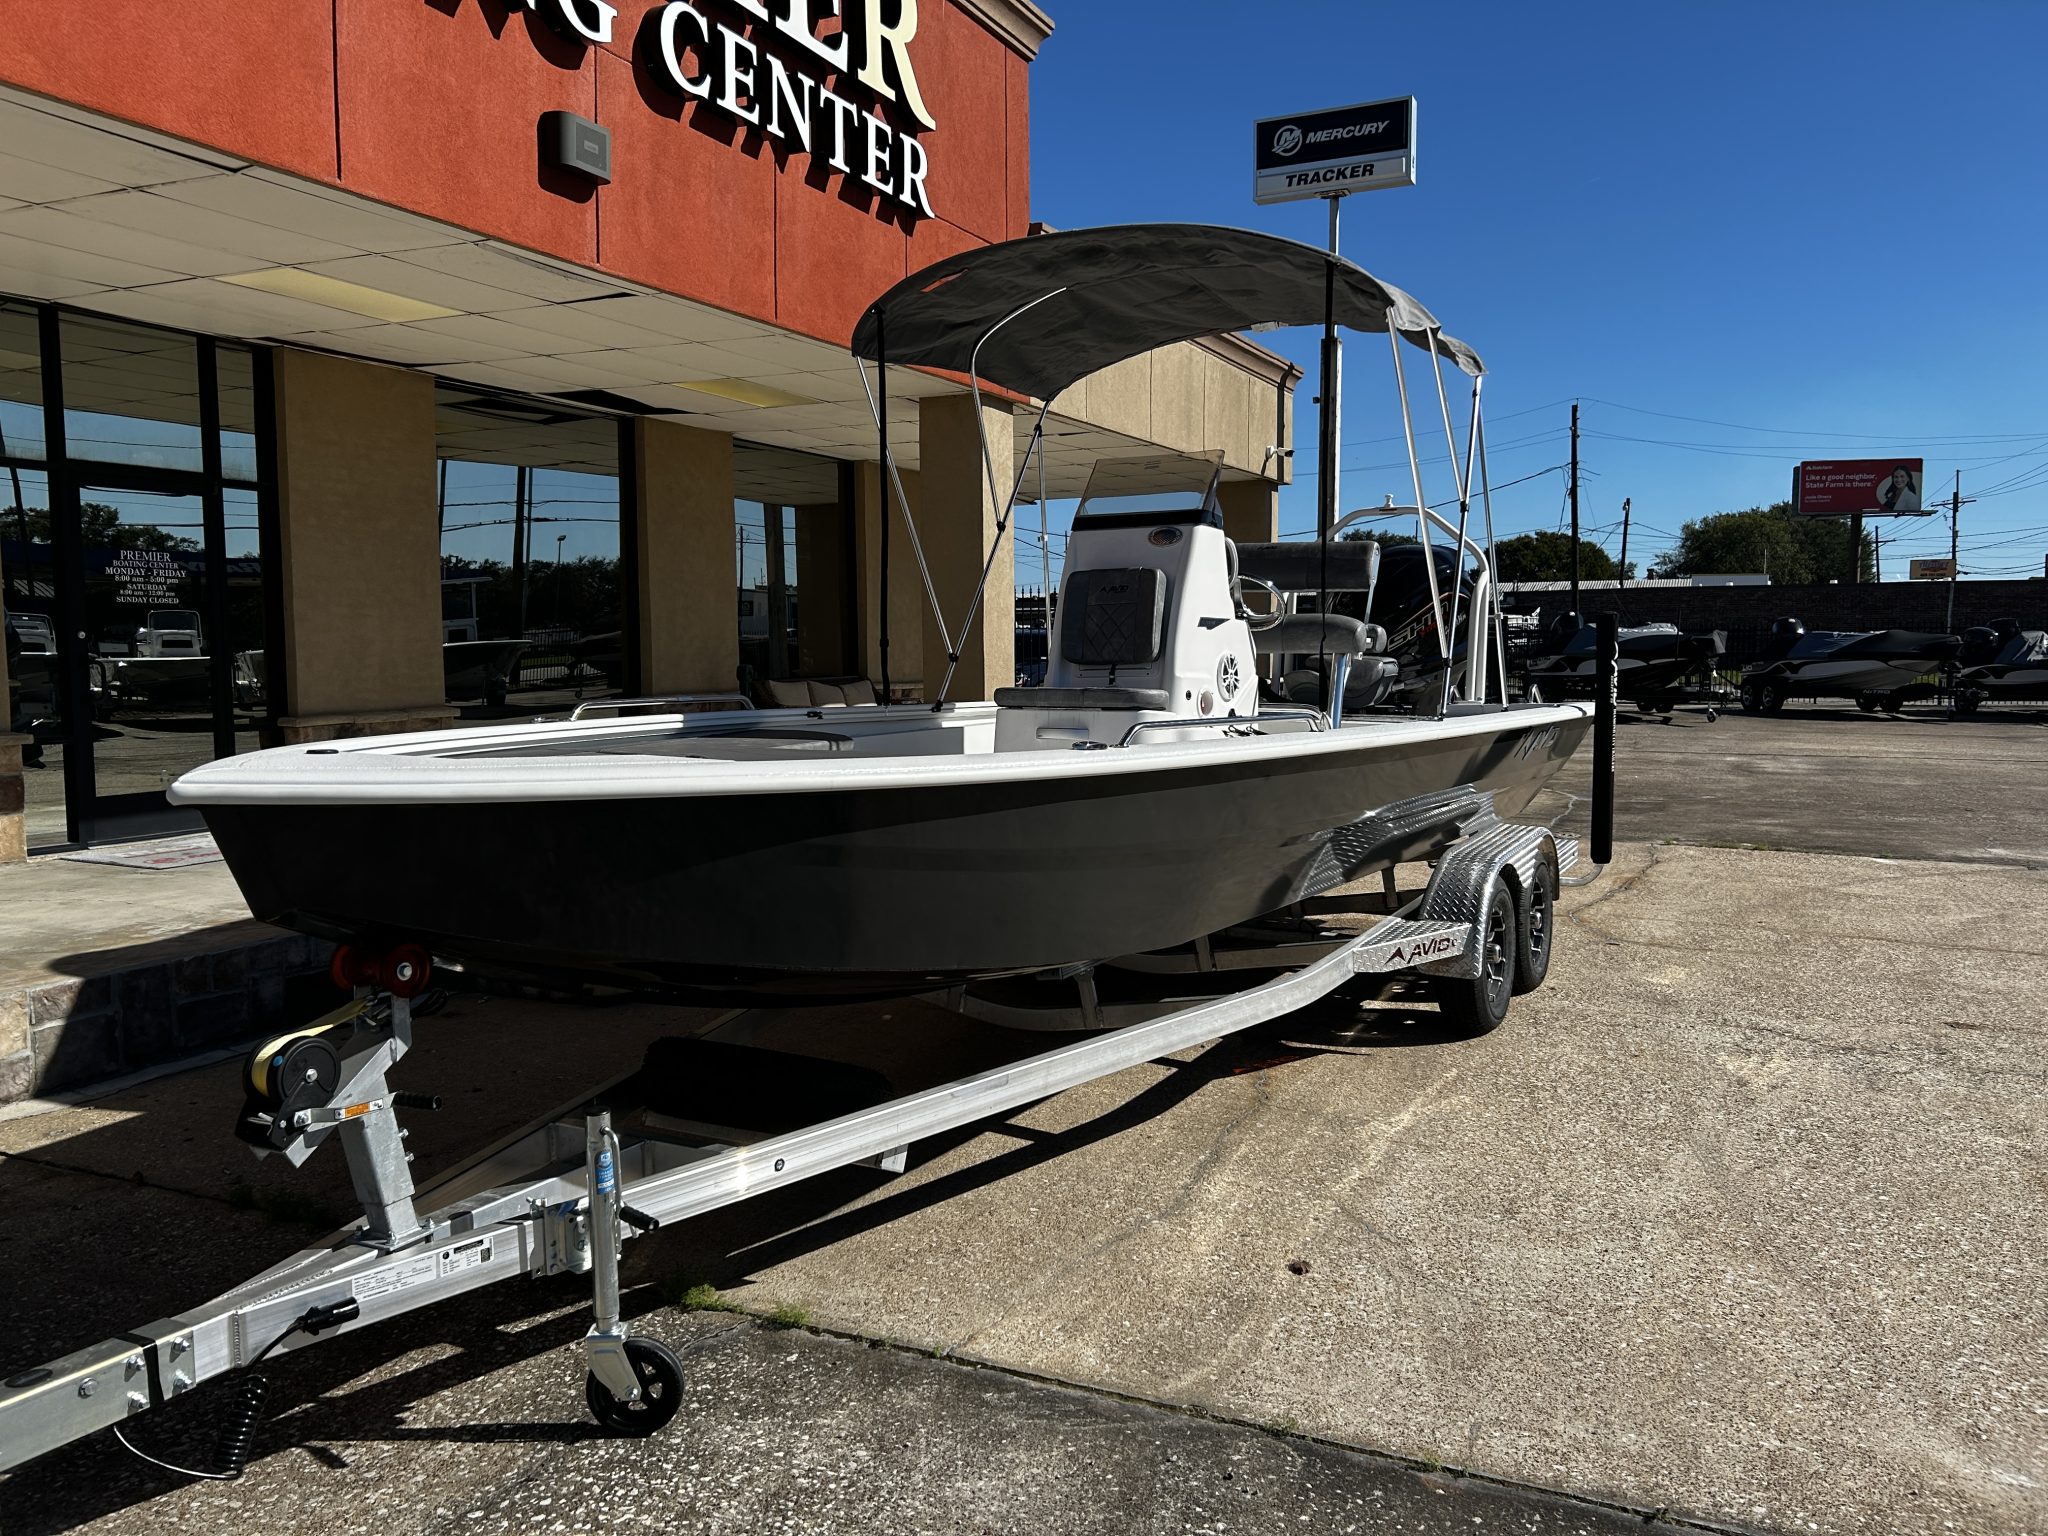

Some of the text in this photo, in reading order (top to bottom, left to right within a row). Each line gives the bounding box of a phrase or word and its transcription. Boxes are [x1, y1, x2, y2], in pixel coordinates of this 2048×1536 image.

[660, 0, 935, 218] CENTER
[1305, 120, 1390, 144] MERCURY
[1286, 163, 1375, 187] TRACKER
[120, 549, 171, 562] PREMIER
[113, 560, 148, 568] BOATING
[149, 561, 179, 569] CENTER
[105, 566, 147, 576] MONDAY
[153, 568, 187, 578] FRIDAY
[126, 583, 167, 591] SATURDAY
